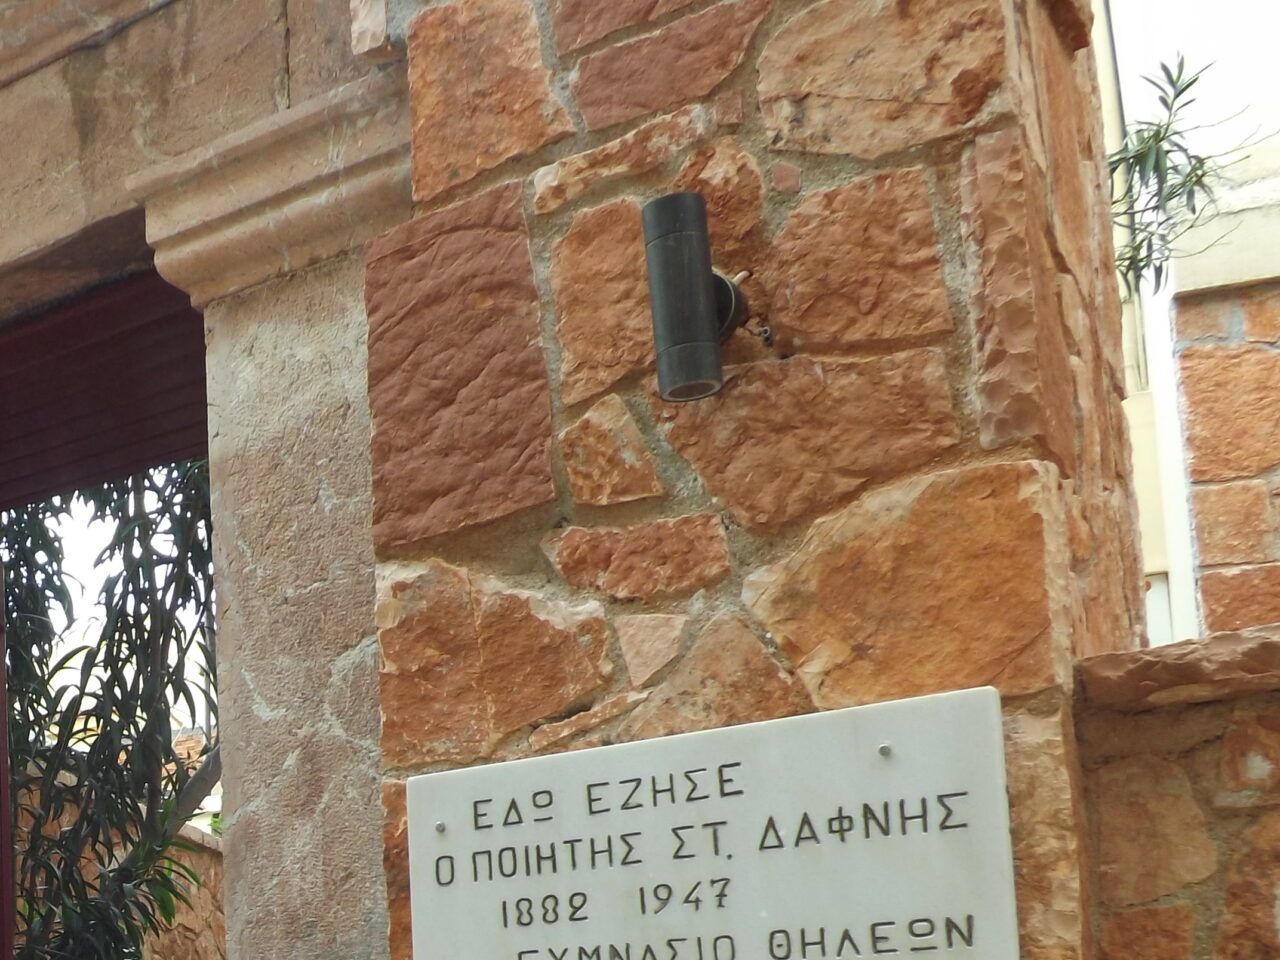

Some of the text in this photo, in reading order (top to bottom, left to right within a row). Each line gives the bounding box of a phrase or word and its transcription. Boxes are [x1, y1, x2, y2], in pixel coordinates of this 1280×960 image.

[473, 762, 745, 830] ΕΔΩ ΕΖΗΣΕ
[436, 791, 970, 887] Ο ΠΟΙΗΤΗΣ ΣΤ. ΔΑΦΝΗΣ
[502, 878, 733, 928] 1882 1947
